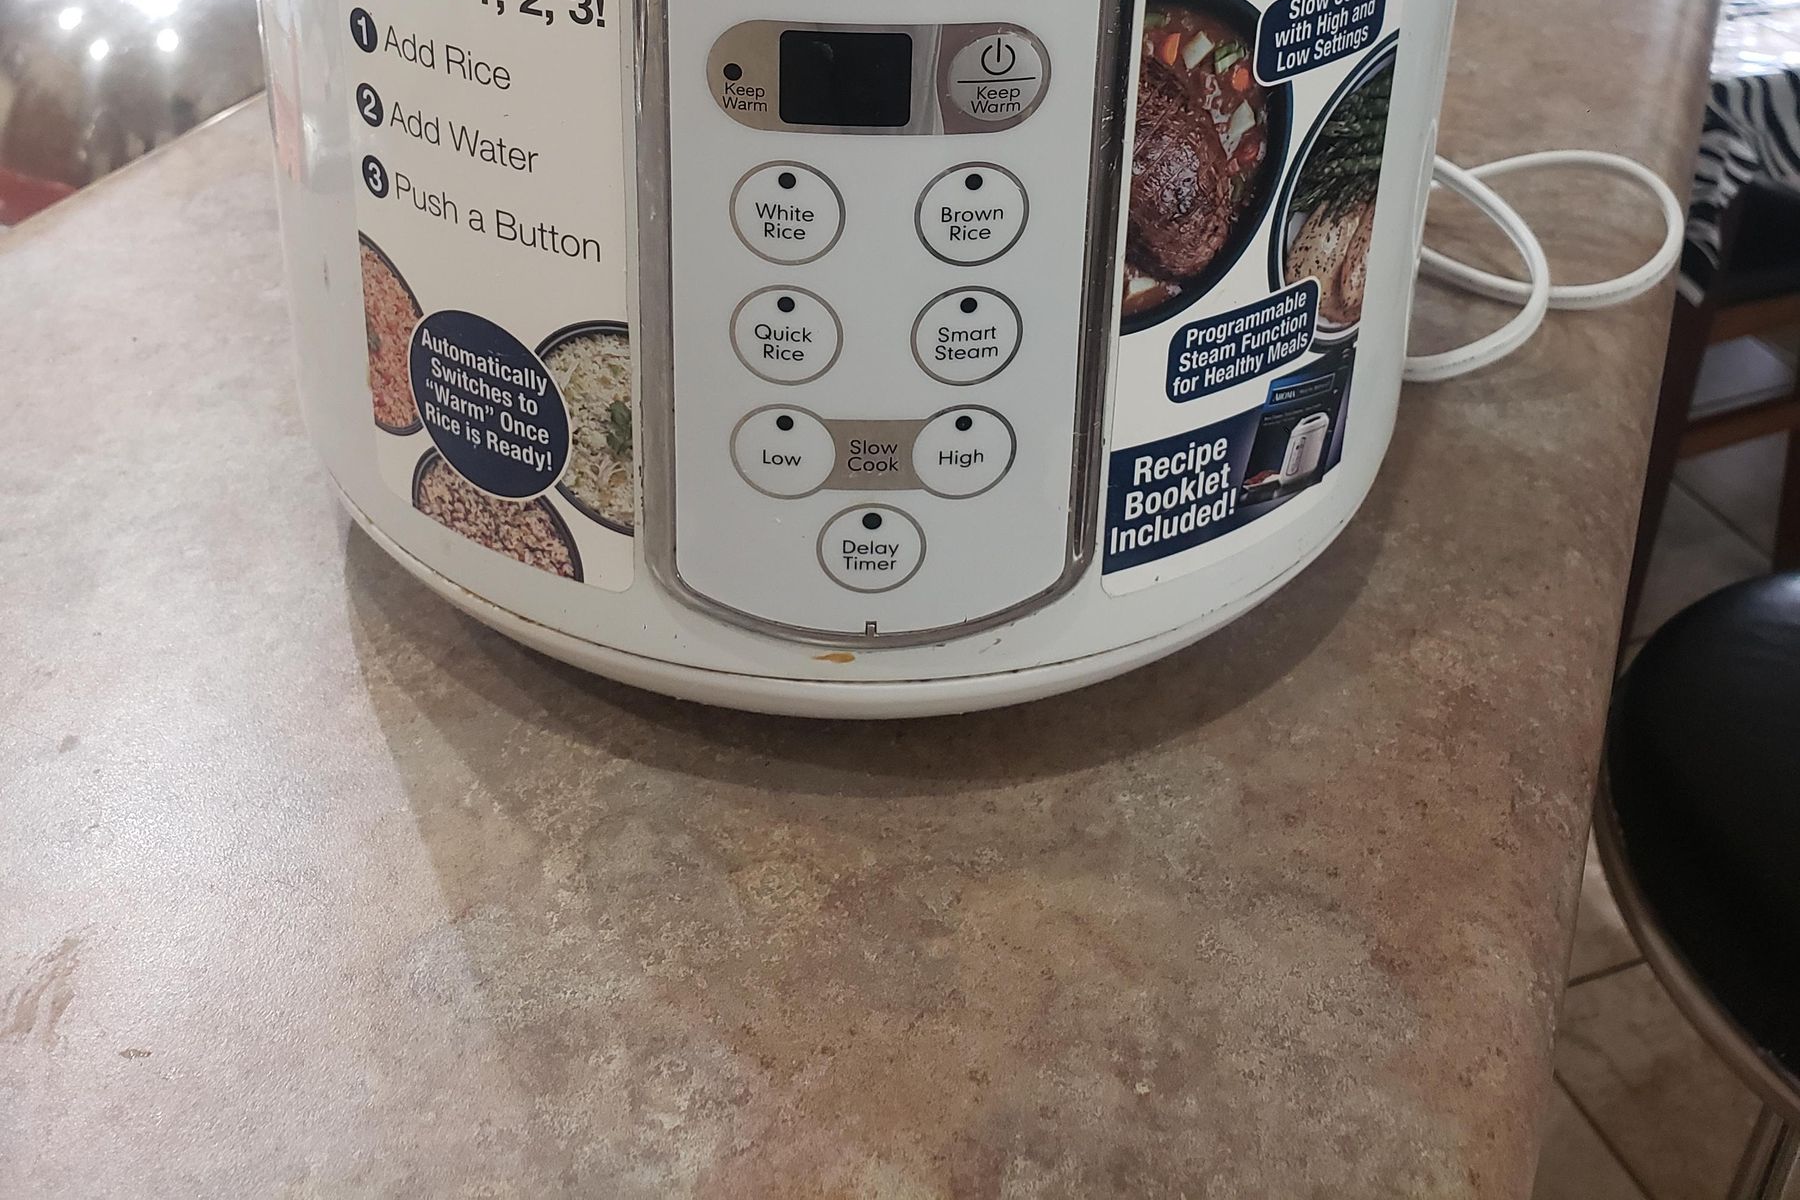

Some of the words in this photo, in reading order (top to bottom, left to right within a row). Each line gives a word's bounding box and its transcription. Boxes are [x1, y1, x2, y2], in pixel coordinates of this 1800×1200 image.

[1275, 22, 1311, 48] with
[1317, 10, 1347, 36] High
[385, 25, 435, 69] Add
[446, 44, 510, 90] Rice
[1276, 49, 1310, 72] Low
[1314, 24, 1368, 61] Settings
[724, 83, 765, 100] Keep
[976, 85, 1021, 101] Keep
[722, 96, 768, 112] Warm
[971, 100, 1021, 114] Warm
[390, 101, 440, 146] Add
[449, 121, 539, 173] Water
[395, 172, 458, 224] Push
[469, 209, 485, 233] a
[496, 209, 601, 262] Button
[755, 202, 815, 222] White
[941, 206, 1004, 223] Brown
[763, 222, 806, 241] Rice
[949, 224, 991, 241] Rice
[1186, 290, 1306, 348] Programmable
[754, 324, 812, 343] Quick
[938, 325, 997, 342] Smart
[1178, 341, 1236, 372] Steam
[1241, 312, 1307, 354] Function
[763, 344, 805, 361] Rice
[935, 344, 999, 361] Steam
[421, 328, 547, 397] Automatically
[1173, 376, 1199, 396] for
[1204, 353, 1263, 388] Healthy
[1267, 332, 1308, 364] Meals
[431, 357, 512, 407] Switches
[519, 393, 538, 416] to
[425, 402, 461, 435] Rice
[465, 422, 481, 444] is
[486, 430, 552, 472] Ready!
[500, 412, 549, 444] Once
[850, 439, 898, 456] Slow
[762, 449, 801, 466] Low
[847, 456, 898, 472] Cook
[938, 449, 984, 467] High
[1133, 437, 1228, 486] Recipe
[1124, 462, 1231, 520] Booklet
[1110, 488, 1236, 555] Included!
[842, 539, 899, 557] Delay
[843, 556, 897, 570] Timer
